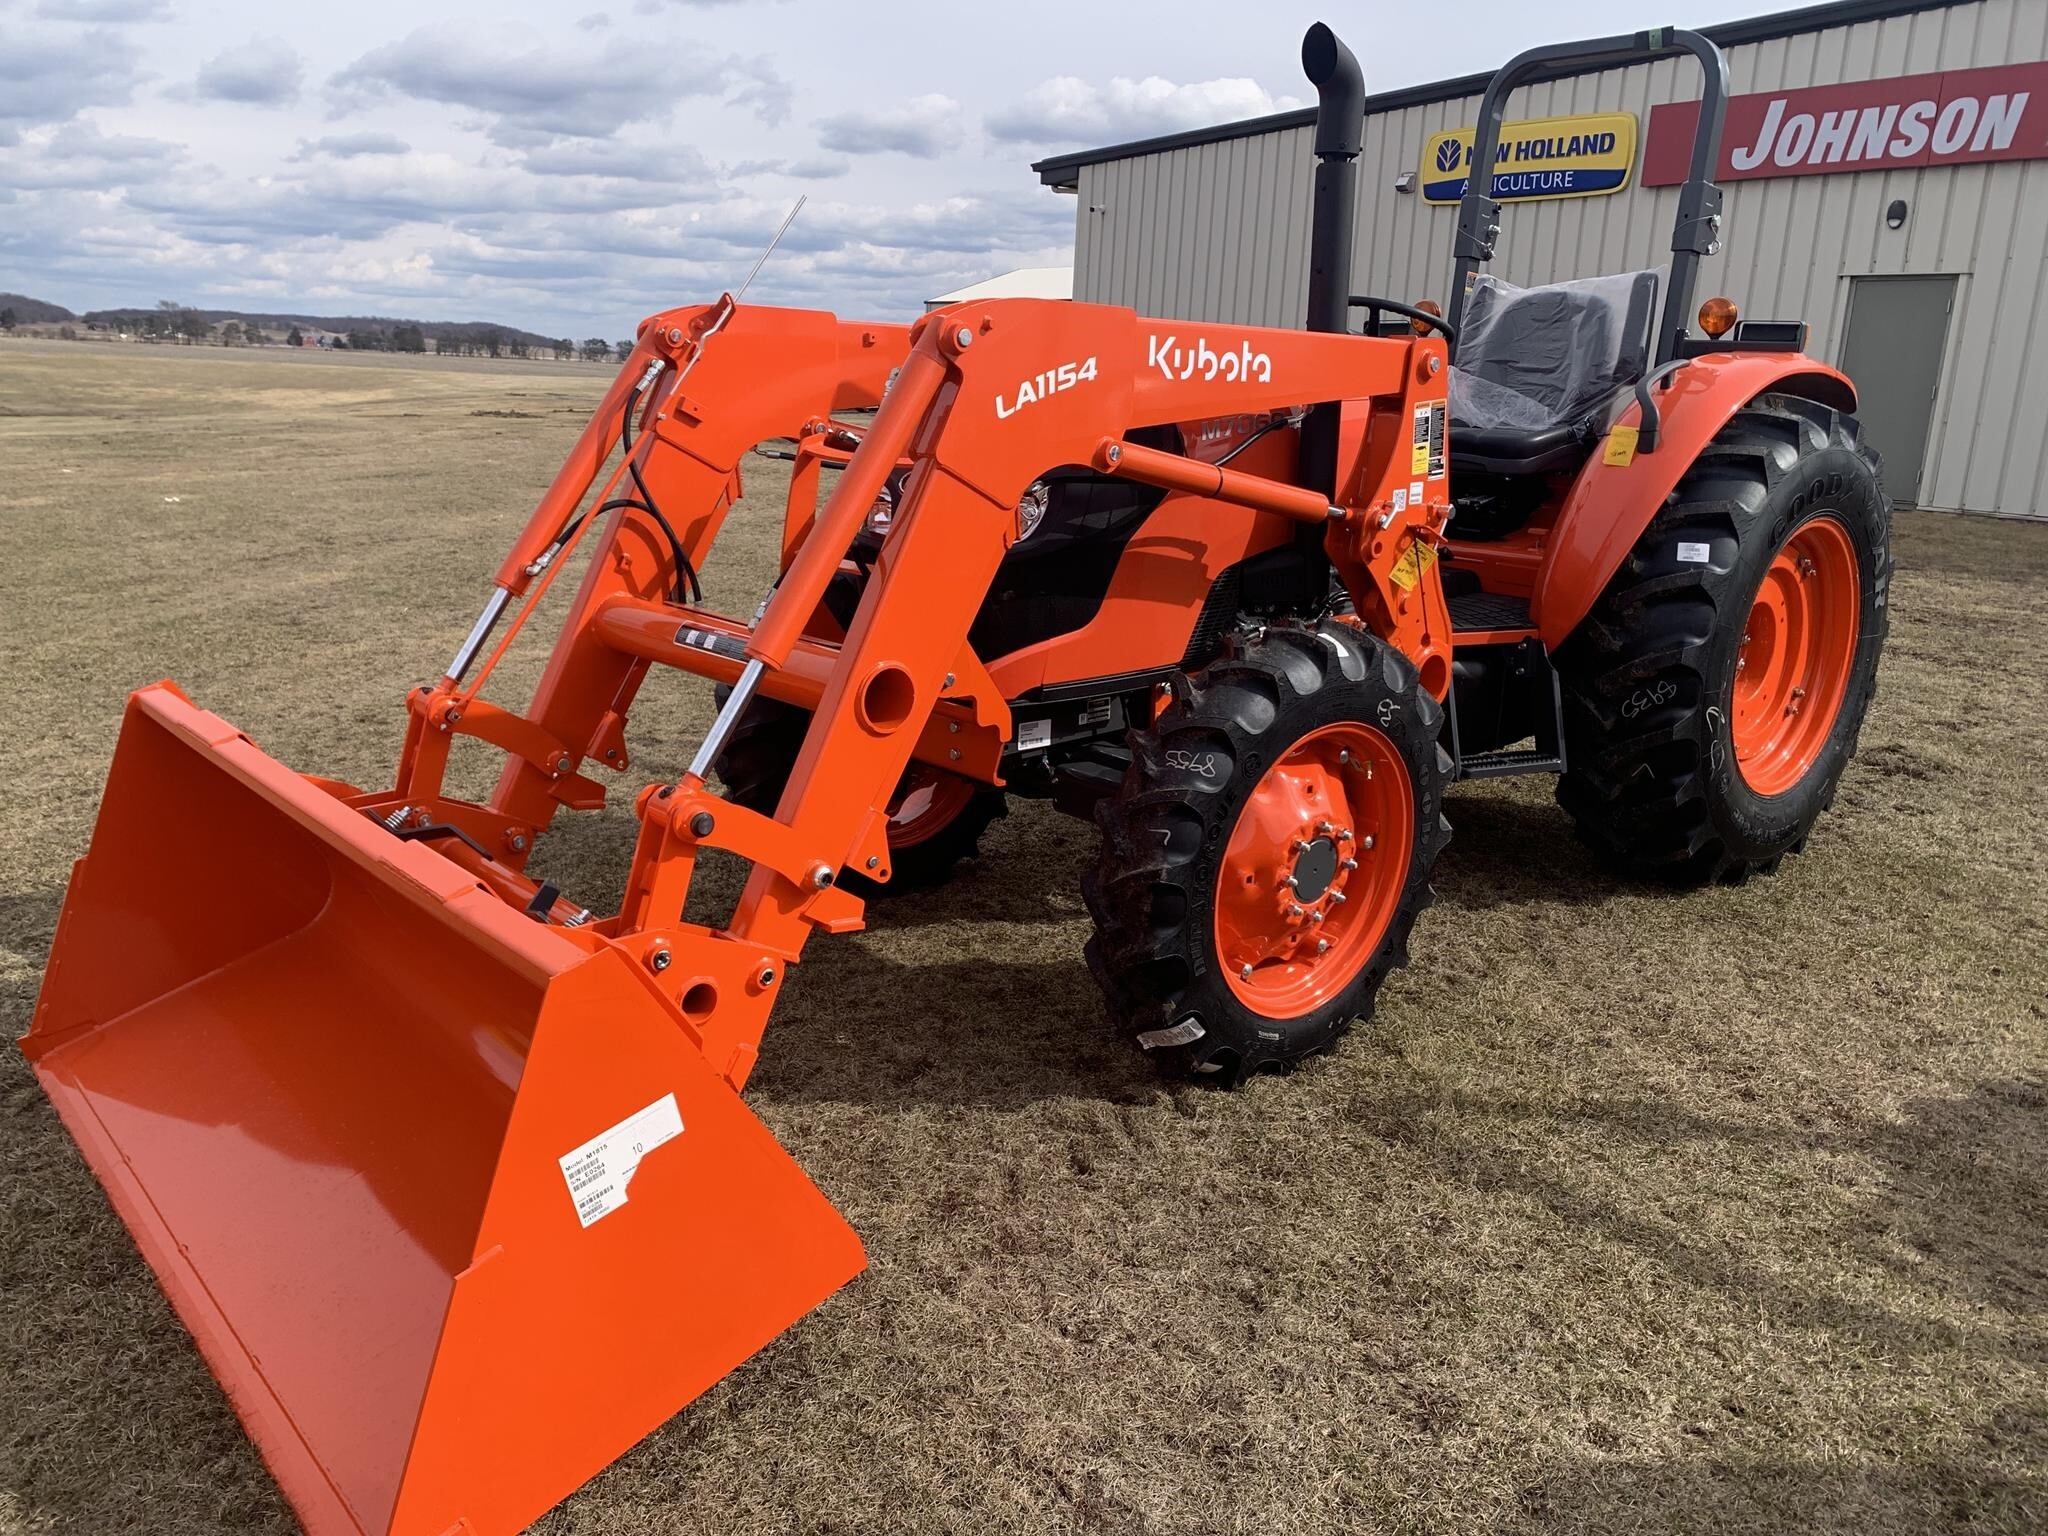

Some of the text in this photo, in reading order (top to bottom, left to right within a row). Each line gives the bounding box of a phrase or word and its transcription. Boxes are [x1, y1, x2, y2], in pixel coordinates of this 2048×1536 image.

[1465, 132, 1616, 166] NW HOLLAND
[1731, 92, 2030, 171] JOHNSON
[1460, 171, 1575, 194] AICULTURE
[1148, 334, 1272, 383] Kubota
[995, 356, 1099, 420] LA1154
